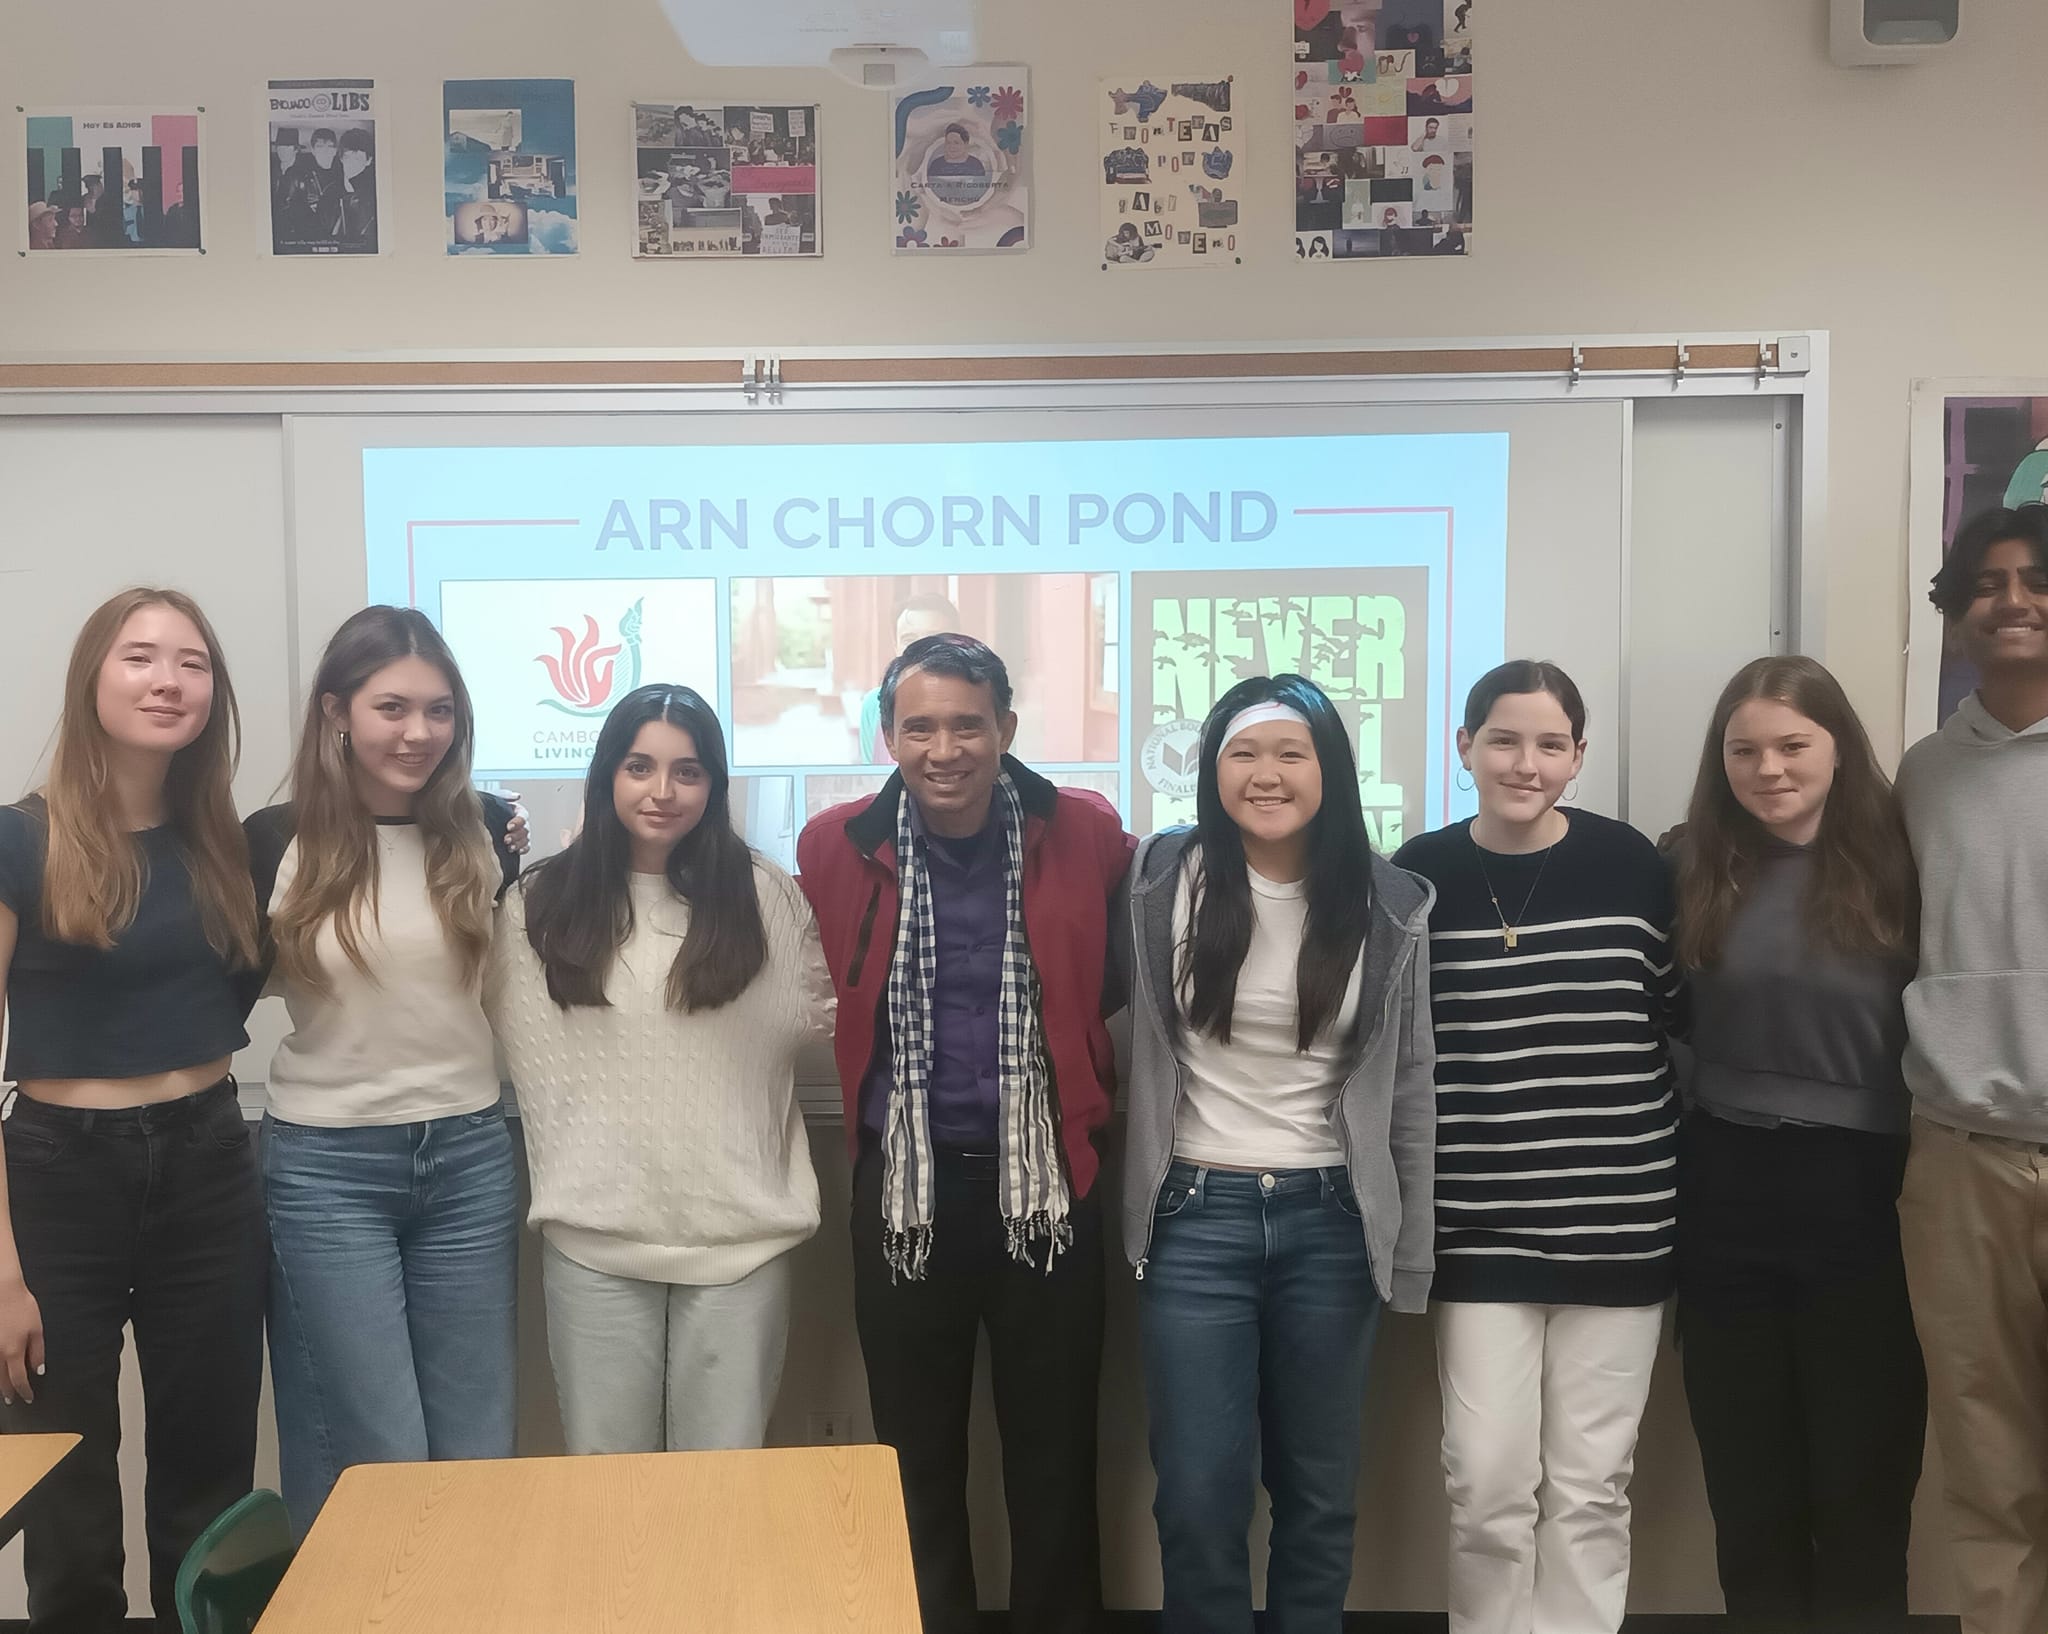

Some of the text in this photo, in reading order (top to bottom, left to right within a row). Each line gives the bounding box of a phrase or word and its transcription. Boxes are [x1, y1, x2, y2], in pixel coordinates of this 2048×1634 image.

[330, 92, 370, 112] LIBS
[595, 490, 1279, 551] ARN CHORN POND
[1152, 595, 1406, 725] NEVER
[533, 730, 600, 744] CAMBO
